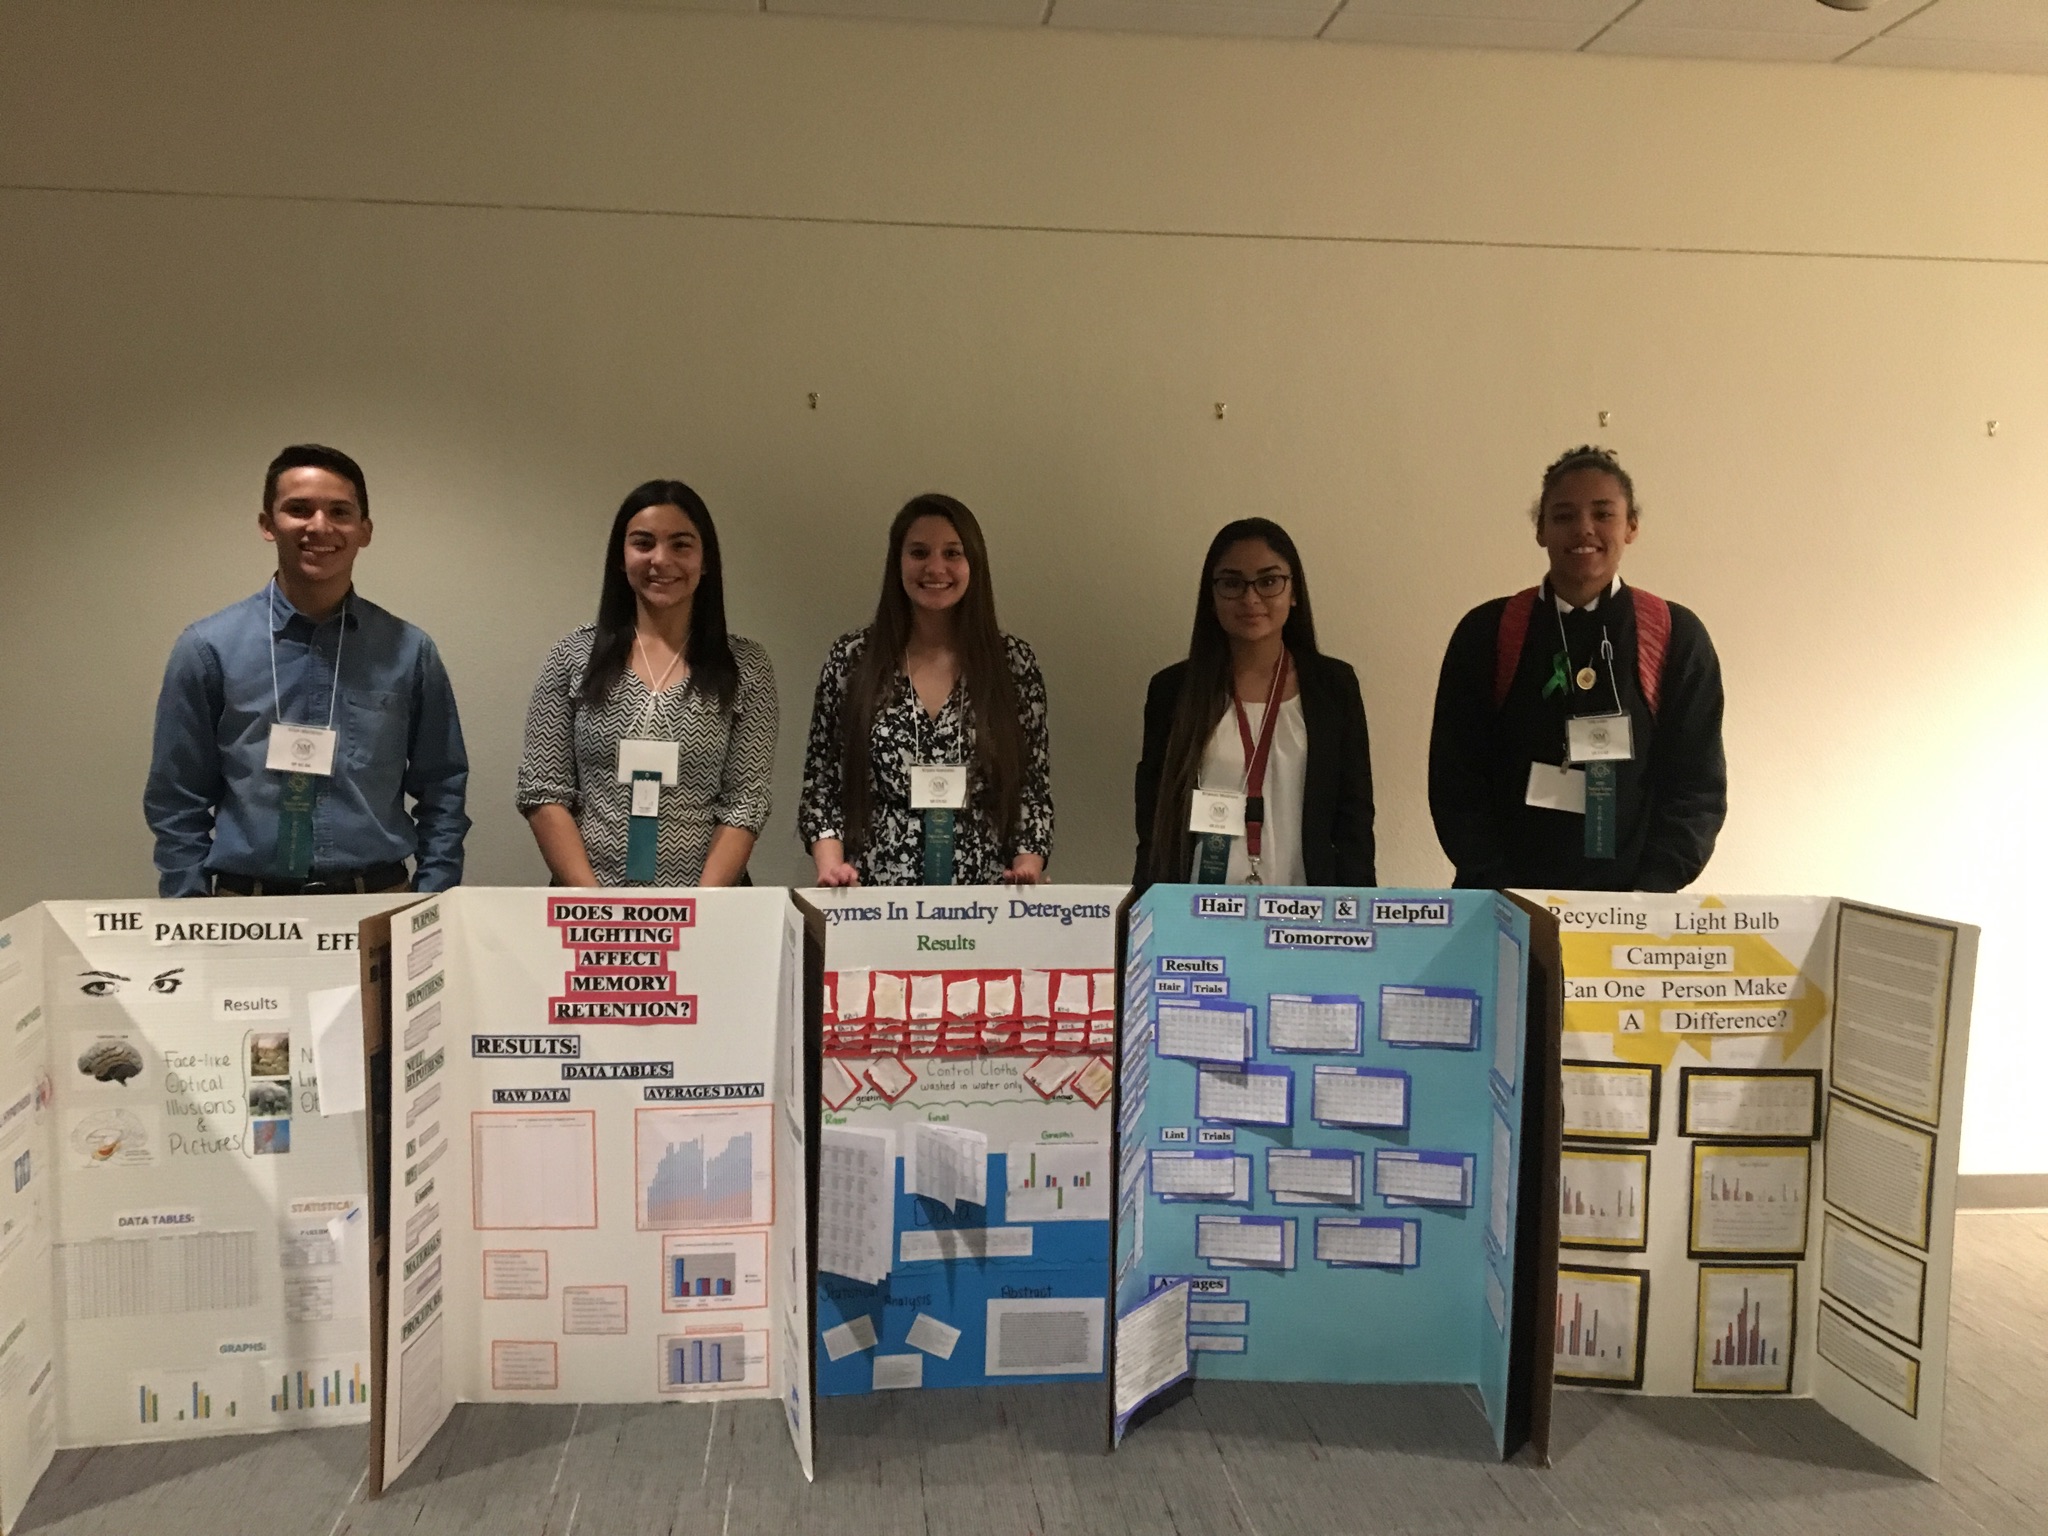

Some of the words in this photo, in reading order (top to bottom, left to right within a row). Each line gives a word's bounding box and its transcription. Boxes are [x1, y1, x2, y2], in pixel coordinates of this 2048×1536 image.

[554, 906, 613, 921] DOES
[623, 907, 688, 922] ROOM
[823, 906, 881, 926] zymes
[886, 901, 908, 920] In
[915, 901, 998, 924] Laundry
[1008, 900, 1110, 925] Detergents
[1201, 899, 1243, 914] Hair
[1264, 900, 1320, 919] Today
[1339, 902, 1353, 915] &
[1375, 905, 1445, 921] Helpful
[413, 908, 439, 931] PURPOSE
[1548, 906, 1647, 930] Recycling
[1675, 912, 1727, 935] Light
[1734, 912, 1780, 930] Bulb
[94, 912, 143, 931] THE
[155, 923, 303, 941] PAREIDOLIA
[317, 933, 360, 950] EFF
[569, 928, 672, 943] LIGHTING
[1272, 930, 1369, 947] Tomorrow
[917, 935, 976, 950] Results
[580, 951, 659, 967] AFFECT
[1165, 959, 1219, 973] Results
[1627, 947, 1727, 970] Campaign
[572, 975, 668, 991] MEMORY
[1158, 983, 1181, 991] Hair
[1194, 984, 1222, 994] Trials
[1563, 981, 1598, 998] Can
[1604, 980, 1645, 998] One
[1662, 982, 1727, 998] Person
[1734, 978, 1788, 996] Make
[224, 999, 278, 1011] Results
[556, 1002, 690, 1019] RETENTION?
[1624, 1014, 1640, 1030] A
[1675, 1010, 1787, 1030] Difference?
[476, 1038, 578, 1055] RESULTS:
[565, 1065, 606, 1078] DATA
[926, 1060, 975, 1077] Control
[981, 1060, 1018, 1076] Cloths
[166, 1072, 223, 1093] Optical
[920, 1081, 956, 1091] washed
[959, 1081, 970, 1090] in
[973, 1080, 999, 1089] water
[1004, 1080, 1022, 1092] only
[497, 1090, 526, 1102] RAW
[531, 1089, 569, 1102] DATA
[646, 1085, 719, 1099] AVERAGES
[724, 1084, 762, 1097] DATA
[167, 1099, 235, 1117] Illusions
[825, 1113, 847, 1124] Raw
[1165, 1131, 1185, 1139] Lint
[1203, 1132, 1231, 1141] Trials
[168, 1134, 241, 1157] Pictures
[291, 1200, 353, 1213] STATISTICA
[118, 1216, 149, 1226] DATA
[152, 1213, 195, 1224] TABLES:
[1001, 1285, 1052, 1299] Abstract
[1160, 1278, 1224, 1291] Aages
[884, 1294, 932, 1312] Analysis
[219, 1343, 267, 1354] GRAPHS:
